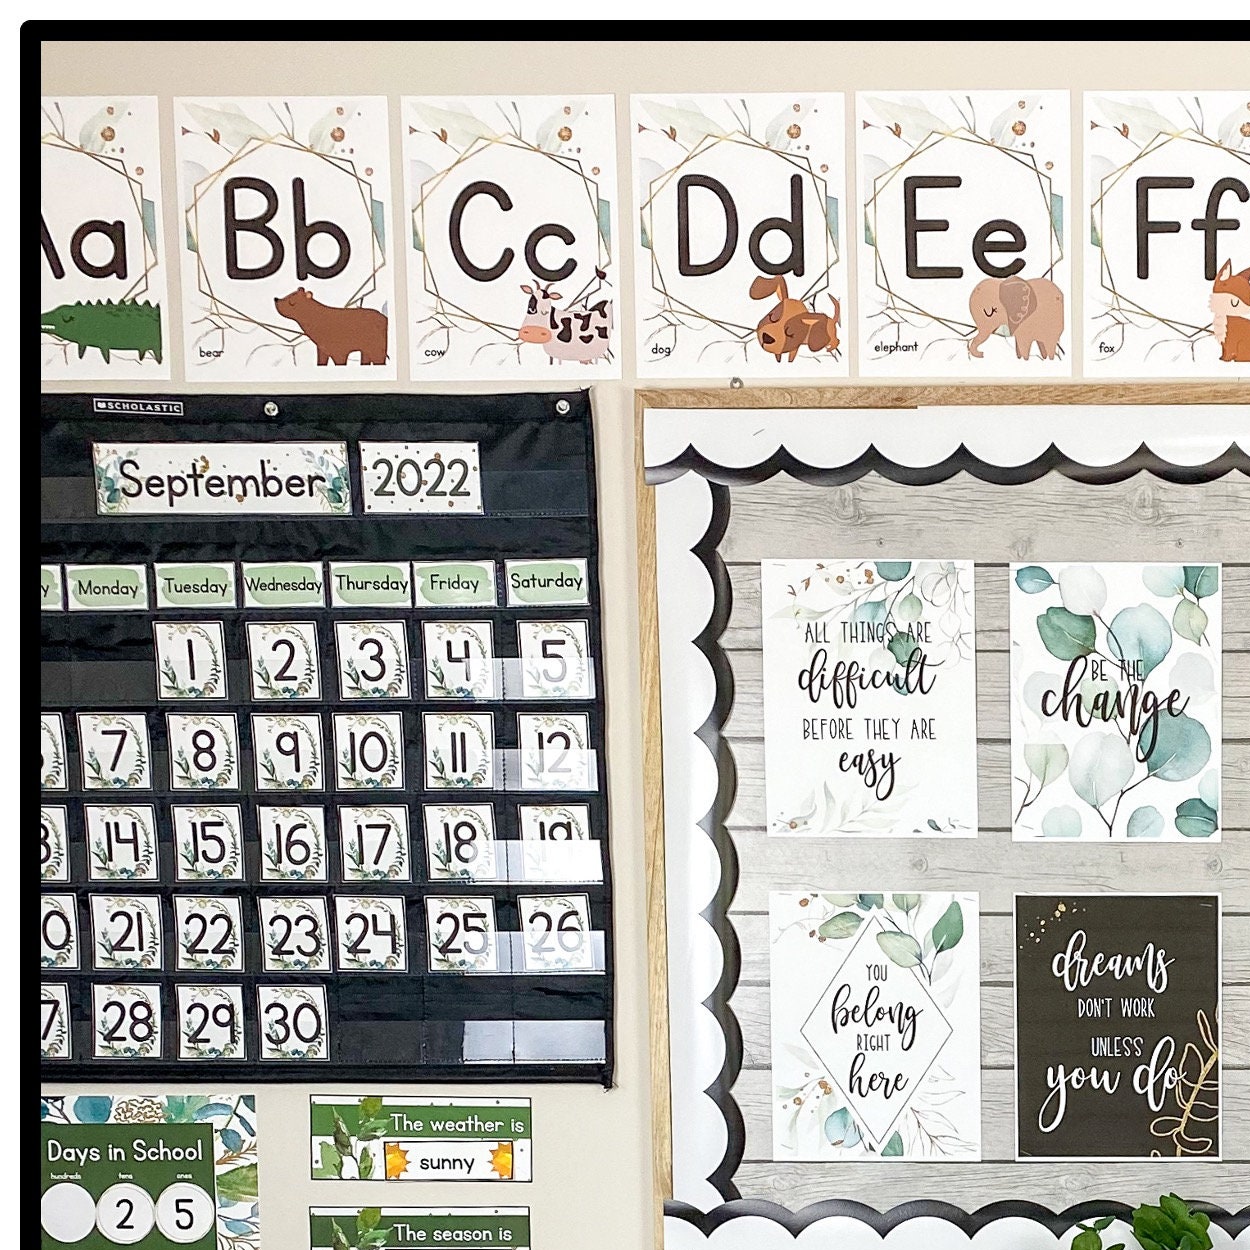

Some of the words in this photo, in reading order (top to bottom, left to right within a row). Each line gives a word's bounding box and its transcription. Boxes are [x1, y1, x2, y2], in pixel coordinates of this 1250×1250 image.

[224, 176, 352, 281] Bb
[448, 179, 579, 282] Cc
[676, 172, 805, 278] Dd
[903, 175, 1027, 280] Ee
[1136, 176, 1250, 281] Ff
[199, 347, 224, 358] bear
[424, 348, 446, 358] cow
[651, 343, 672, 357] dog
[874, 342, 919, 354] elephant
[1098, 343, 1116, 354] fox
[107, 402, 181, 412] SCHOLASTIC
[120, 459, 326, 507] September
[372, 458, 471, 498] 2022
[78, 580, 139, 600] Monday
[163, 577, 228, 597] Tuesday
[245, 576, 323, 595] Wednesday
[335, 574, 409, 594] Thursday
[430, 573, 480, 594] Friday
[511, 571, 583, 592] Saturday
[805, 621, 831, 643] ALL
[840, 621, 897, 645] THINGS
[907, 620, 932, 644] ARE
[187, 639, 196, 681] 1
[273, 638, 298, 682] 2
[360, 638, 386, 682] 3
[446, 640, 472, 682] 4
[798, 648, 943, 708] difficult
[1091, 659, 1109, 682] BE
[1118, 659, 1144, 682] THE
[803, 718, 854, 741] BEFORE
[863, 718, 902, 740] THEY
[910, 718, 937, 741] ARE
[1042, 654, 1191, 763] change
[101, 729, 128, 773] 7
[192, 729, 217, 773] 8
[275, 730, 300, 774] 9
[349, 730, 388, 774] 10
[451, 731, 466, 774] 11
[838, 748, 901, 801] easy
[105, 821, 138, 862] 14
[192, 821, 226, 864] 15
[276, 823, 311, 866] 16
[357, 823, 391, 866] 17
[110, 912, 143, 952] 21
[185, 913, 234, 955] 22
[269, 914, 320, 957] 23
[344, 913, 395, 955] 24
[865, 963, 888, 983] YOU
[1051, 929, 1176, 993] dreams
[103, 1001, 154, 1043] 28
[186, 1003, 235, 1044] 29
[265, 1002, 321, 1045] 30
[830, 983, 924, 1051] belong
[1077, 998, 1112, 1019] DON'T
[1121, 998, 1155, 1019] WORK
[856, 1033, 891, 1052] RIGHT
[1091, 1036, 1143, 1057] UNLESS
[848, 1053, 909, 1099] here
[1038, 1064, 1121, 1134] you
[1132, 1036, 1187, 1112] do
[389, 1113, 426, 1133] The
[430, 1114, 505, 1134] weather
[509, 1116, 525, 1135] is
[47, 1139, 101, 1167] Days
[108, 1144, 126, 1161] in
[132, 1138, 203, 1161] School
[420, 1153, 475, 1176] sunny
[50, 1172, 82, 1180] hundreds
[116, 1198, 134, 1230] 2
[175, 1198, 194, 1230] 5
[392, 1223, 427, 1243] The
[432, 1226, 493, 1243] season
[497, 1224, 513, 1243] is
